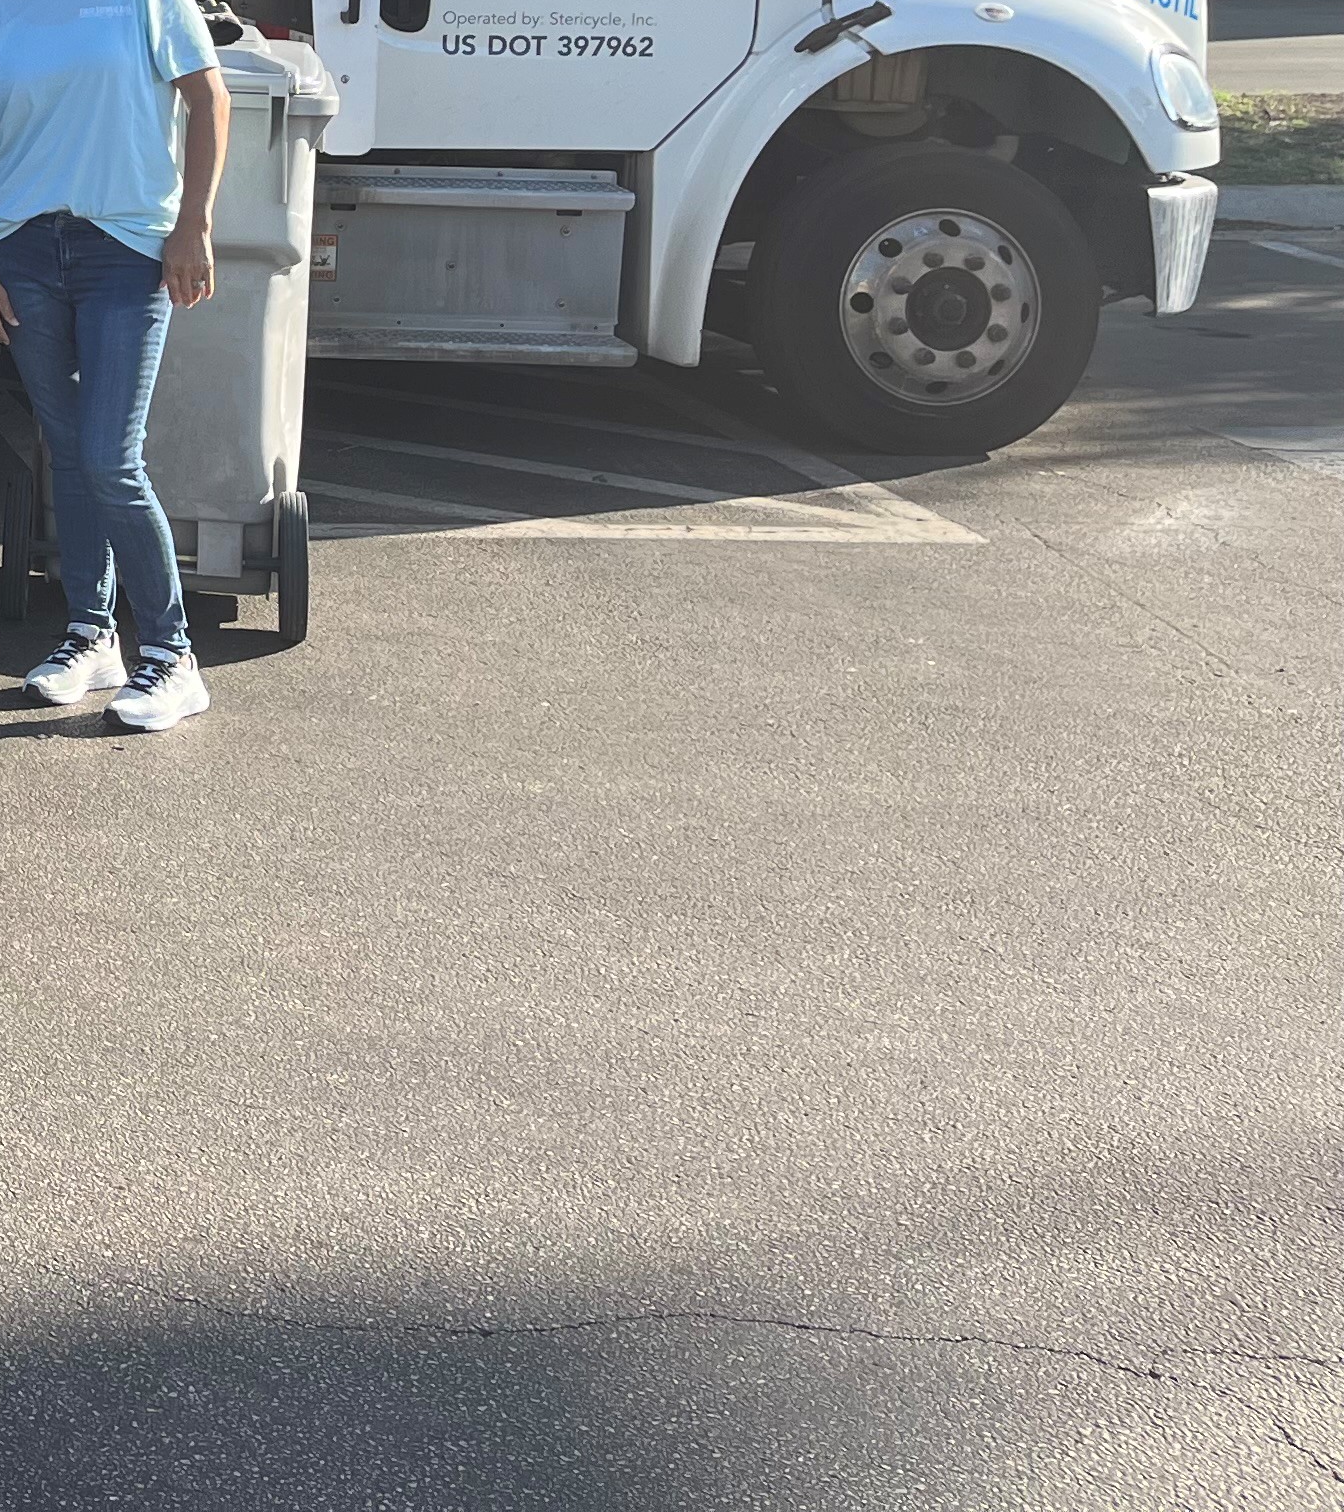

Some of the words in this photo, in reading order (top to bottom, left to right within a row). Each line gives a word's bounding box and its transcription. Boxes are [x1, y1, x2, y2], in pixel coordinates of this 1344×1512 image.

[442, 10, 517, 29] Operated
[549, 11, 626, 29] Stericycle,
[632, 13, 657, 27] Inc.
[442, 34, 477, 56] US
[488, 34, 548, 57] DOT
[557, 35, 654, 58] 397962
